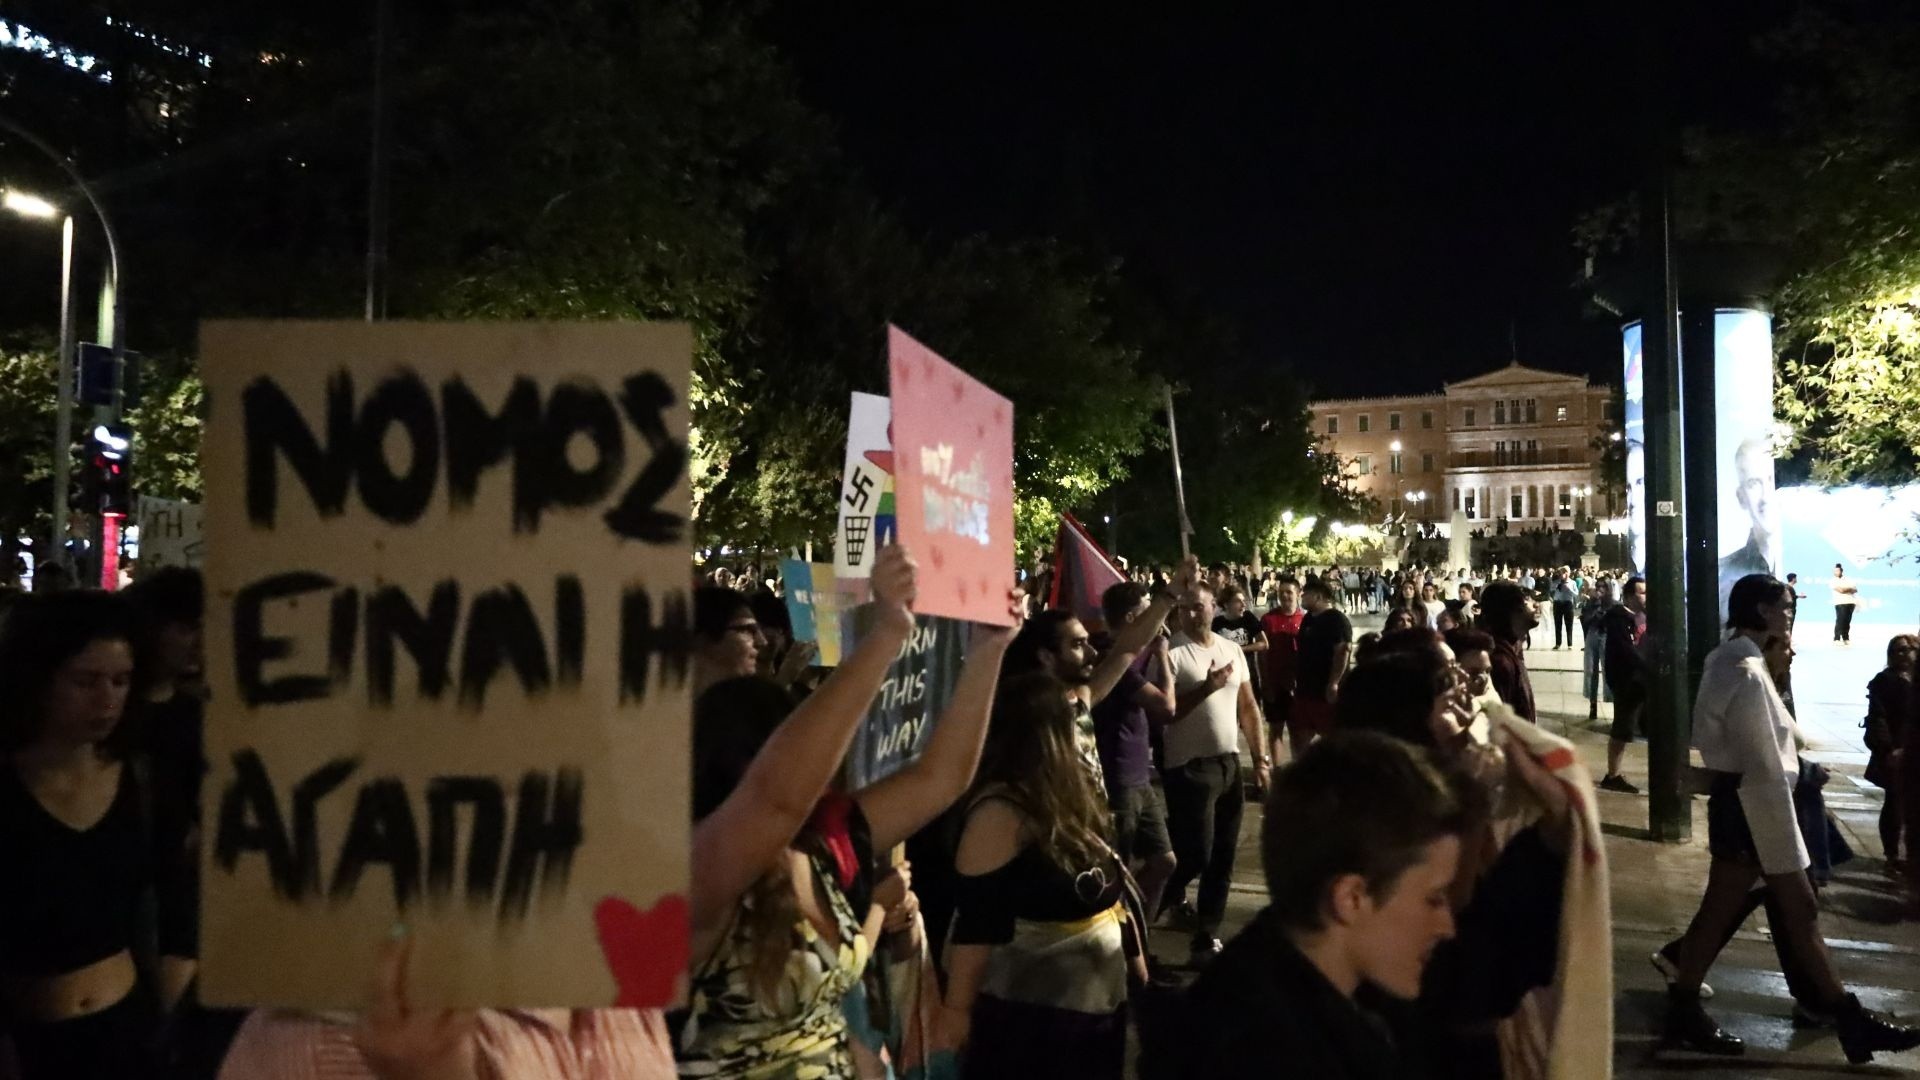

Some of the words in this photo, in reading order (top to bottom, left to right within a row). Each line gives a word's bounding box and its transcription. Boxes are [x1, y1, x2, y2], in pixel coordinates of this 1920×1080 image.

[241, 362, 687, 546] ΝΟΜΟΣ
[232, 571, 586, 714] ΕΙΝΑΙ
[618, 581, 692, 708] Η
[880, 668, 928, 711] THIS
[876, 712, 927, 762] WAY
[213, 749, 585, 929] ΑΓΑΠΗ
